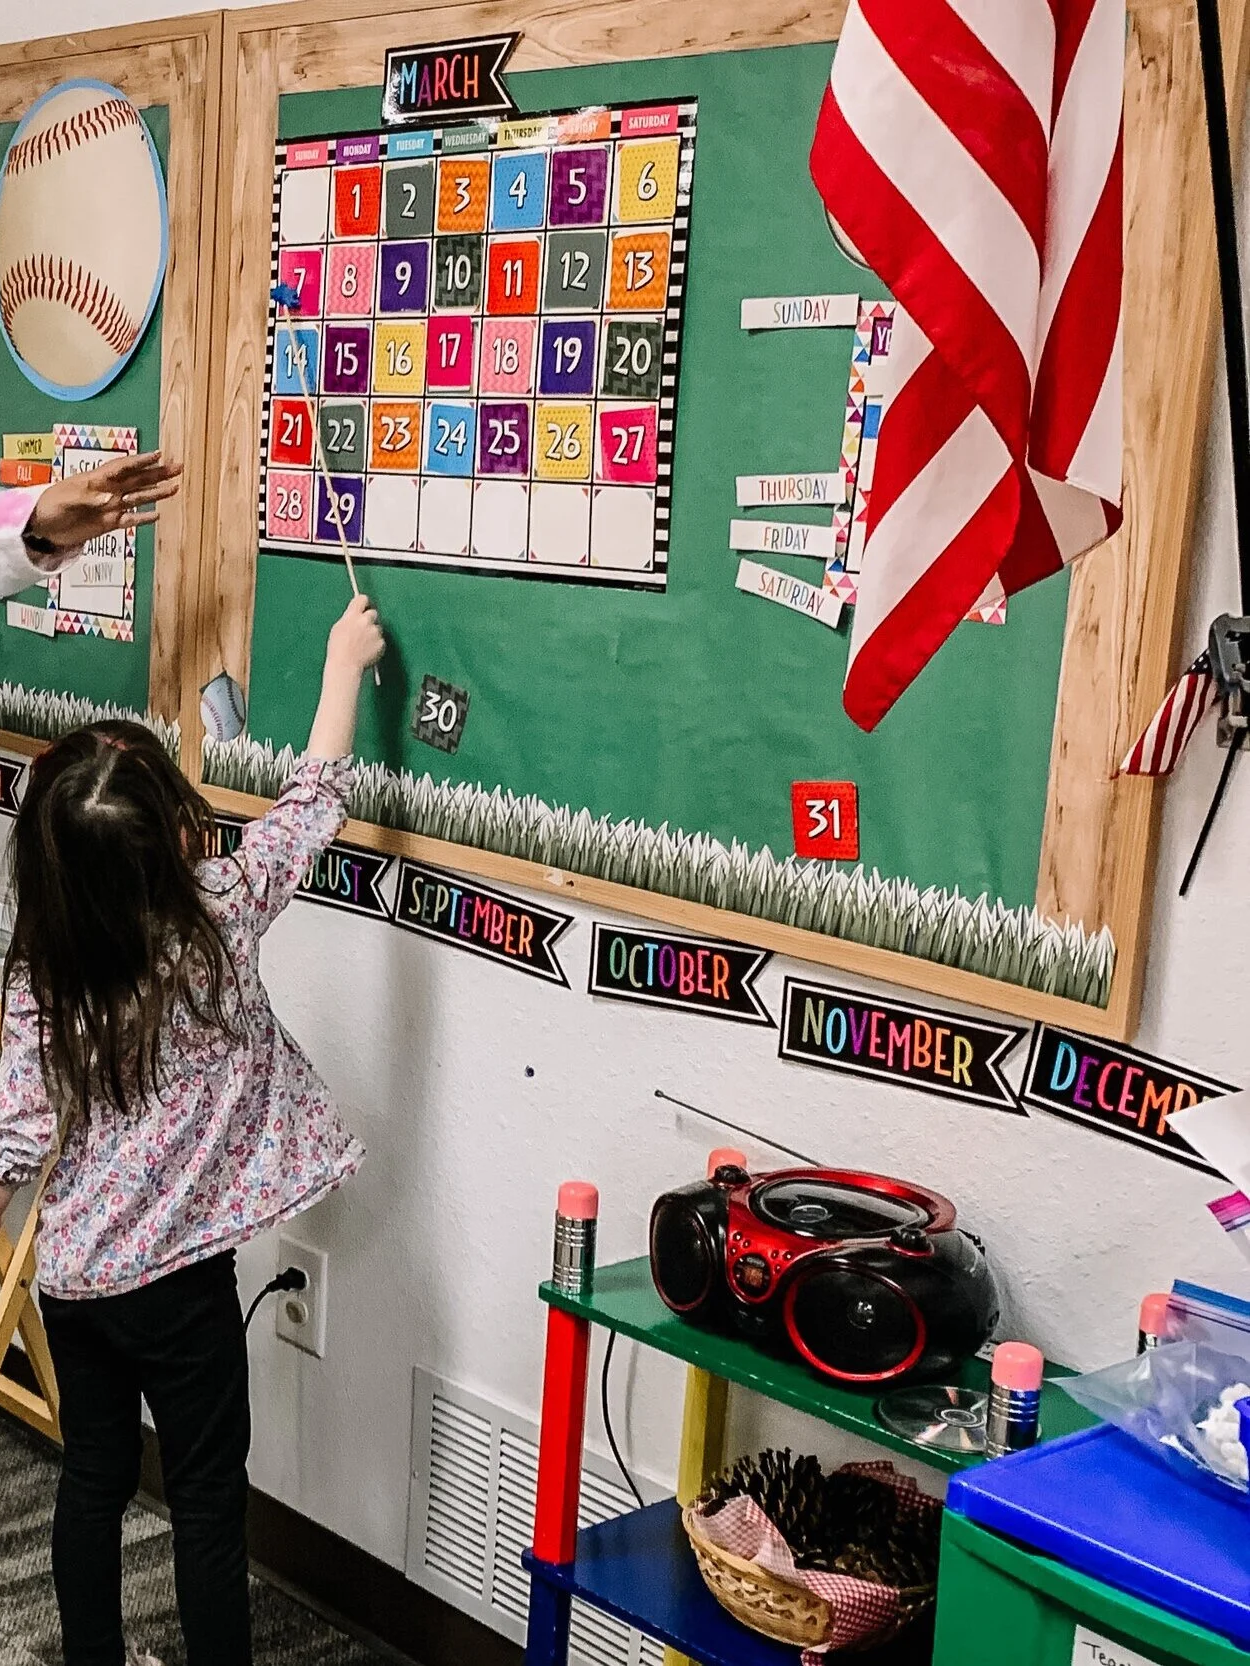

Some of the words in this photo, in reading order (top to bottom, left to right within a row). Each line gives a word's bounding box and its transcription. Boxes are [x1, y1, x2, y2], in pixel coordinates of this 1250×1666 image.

[399, 52, 480, 109] MARCH
[294, 149, 320, 162] SUNDAY
[343, 143, 372, 157] MONDAY
[395, 138, 426, 152] TUESDAY
[444, 130, 488, 147] WEDNESDAY
[504, 126, 543, 140] THURSDAY
[628, 113, 671, 130] SATURDAY
[351, 183, 362, 219] 1
[401, 182, 417, 219] 2
[453, 176, 471, 214] 3
[508, 170, 528, 209] 4
[567, 167, 587, 205] 5
[636, 161, 658, 201] 6
[293, 266, 306, 298] 7
[340, 262, 358, 297] 8
[394, 260, 413, 296] 9
[443, 254, 472, 292] 10
[502, 258, 524, 298] 11
[560, 250, 592, 290] 12
[623, 248, 655, 290] 13
[772, 297, 831, 325] SUNDAY
[284, 343, 307, 380] 14
[333, 341, 358, 378] 15
[385, 340, 413, 376] 16
[438, 332, 461, 368] 17
[492, 337, 520, 375] 18
[553, 335, 582, 374] 19
[612, 335, 651, 376] 20
[16, 437, 43, 455] SUMMER
[279, 411, 305, 447] 21
[326, 417, 356, 454] 22
[380, 414, 412, 450] 23
[434, 418, 467, 456] 24
[487, 418, 522, 456] 25
[544, 421, 582, 462] 26
[610, 424, 647, 465] 27
[16, 464, 33, 482] FALL
[757, 477, 830, 504] THURSDAY
[273, 486, 303, 521] 28
[324, 490, 356, 526] 29
[763, 525, 811, 552] FRIDAY
[82, 561, 114, 585] SUNNY
[757, 570, 825, 618] SATURDAY
[20, 610, 45, 631] WINDY
[419, 690, 458, 735] 30
[804, 798, 842, 841] 31
[301, 851, 363, 903] UGUST
[407, 875, 535, 959] SEPTEMBER
[607, 936, 731, 1001] OCTOBER
[800, 996, 975, 1088] NOVEMBER
